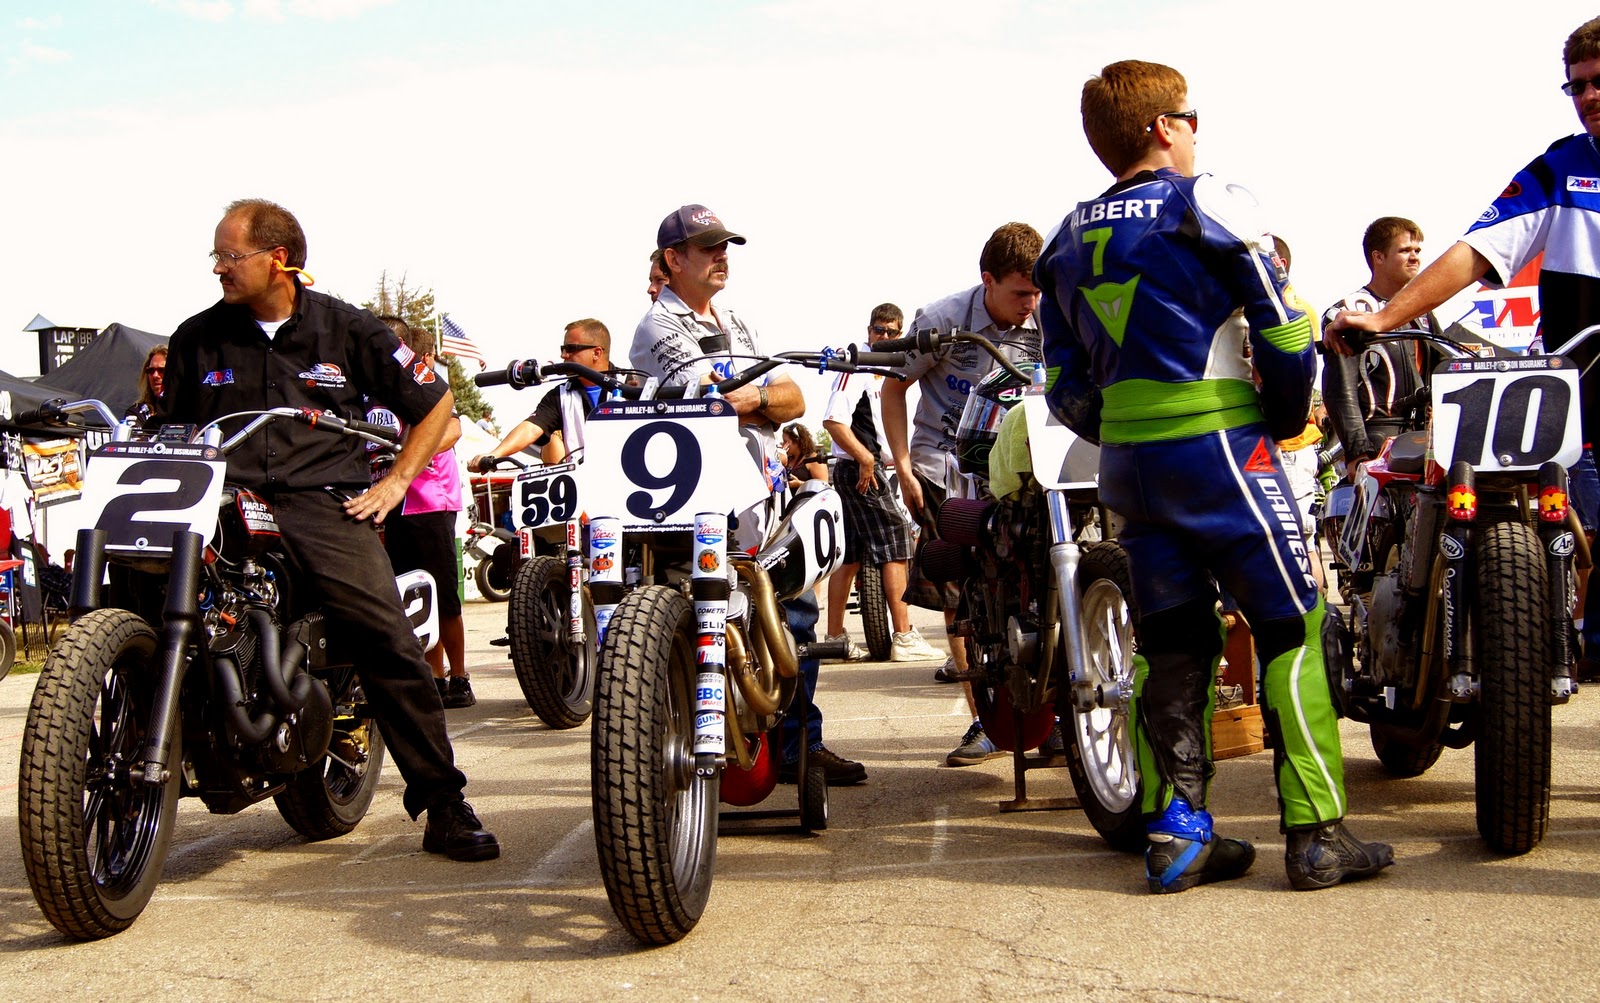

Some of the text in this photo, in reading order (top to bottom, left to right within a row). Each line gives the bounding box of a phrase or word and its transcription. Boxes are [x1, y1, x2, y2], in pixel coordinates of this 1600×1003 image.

[1569, 179, 1598, 188] AMA
[1082, 226, 1112, 277] 7
[53, 330, 75, 344] LAP
[1519, 359, 1547, 369] INSURANCE
[675, 404, 707, 413] INSURANCE
[1442, 374, 1571, 467] 10
[173, 448, 202, 456] INSURANCE
[621, 420, 702, 520] 9
[95, 460, 214, 546] 2
[521, 474, 577, 527] 59
[244, 510, 274, 522] DAVIDSON
[697, 621, 725, 629] HELIX
[696, 687, 723, 701] EBC
[697, 713, 722, 726] GUNK
